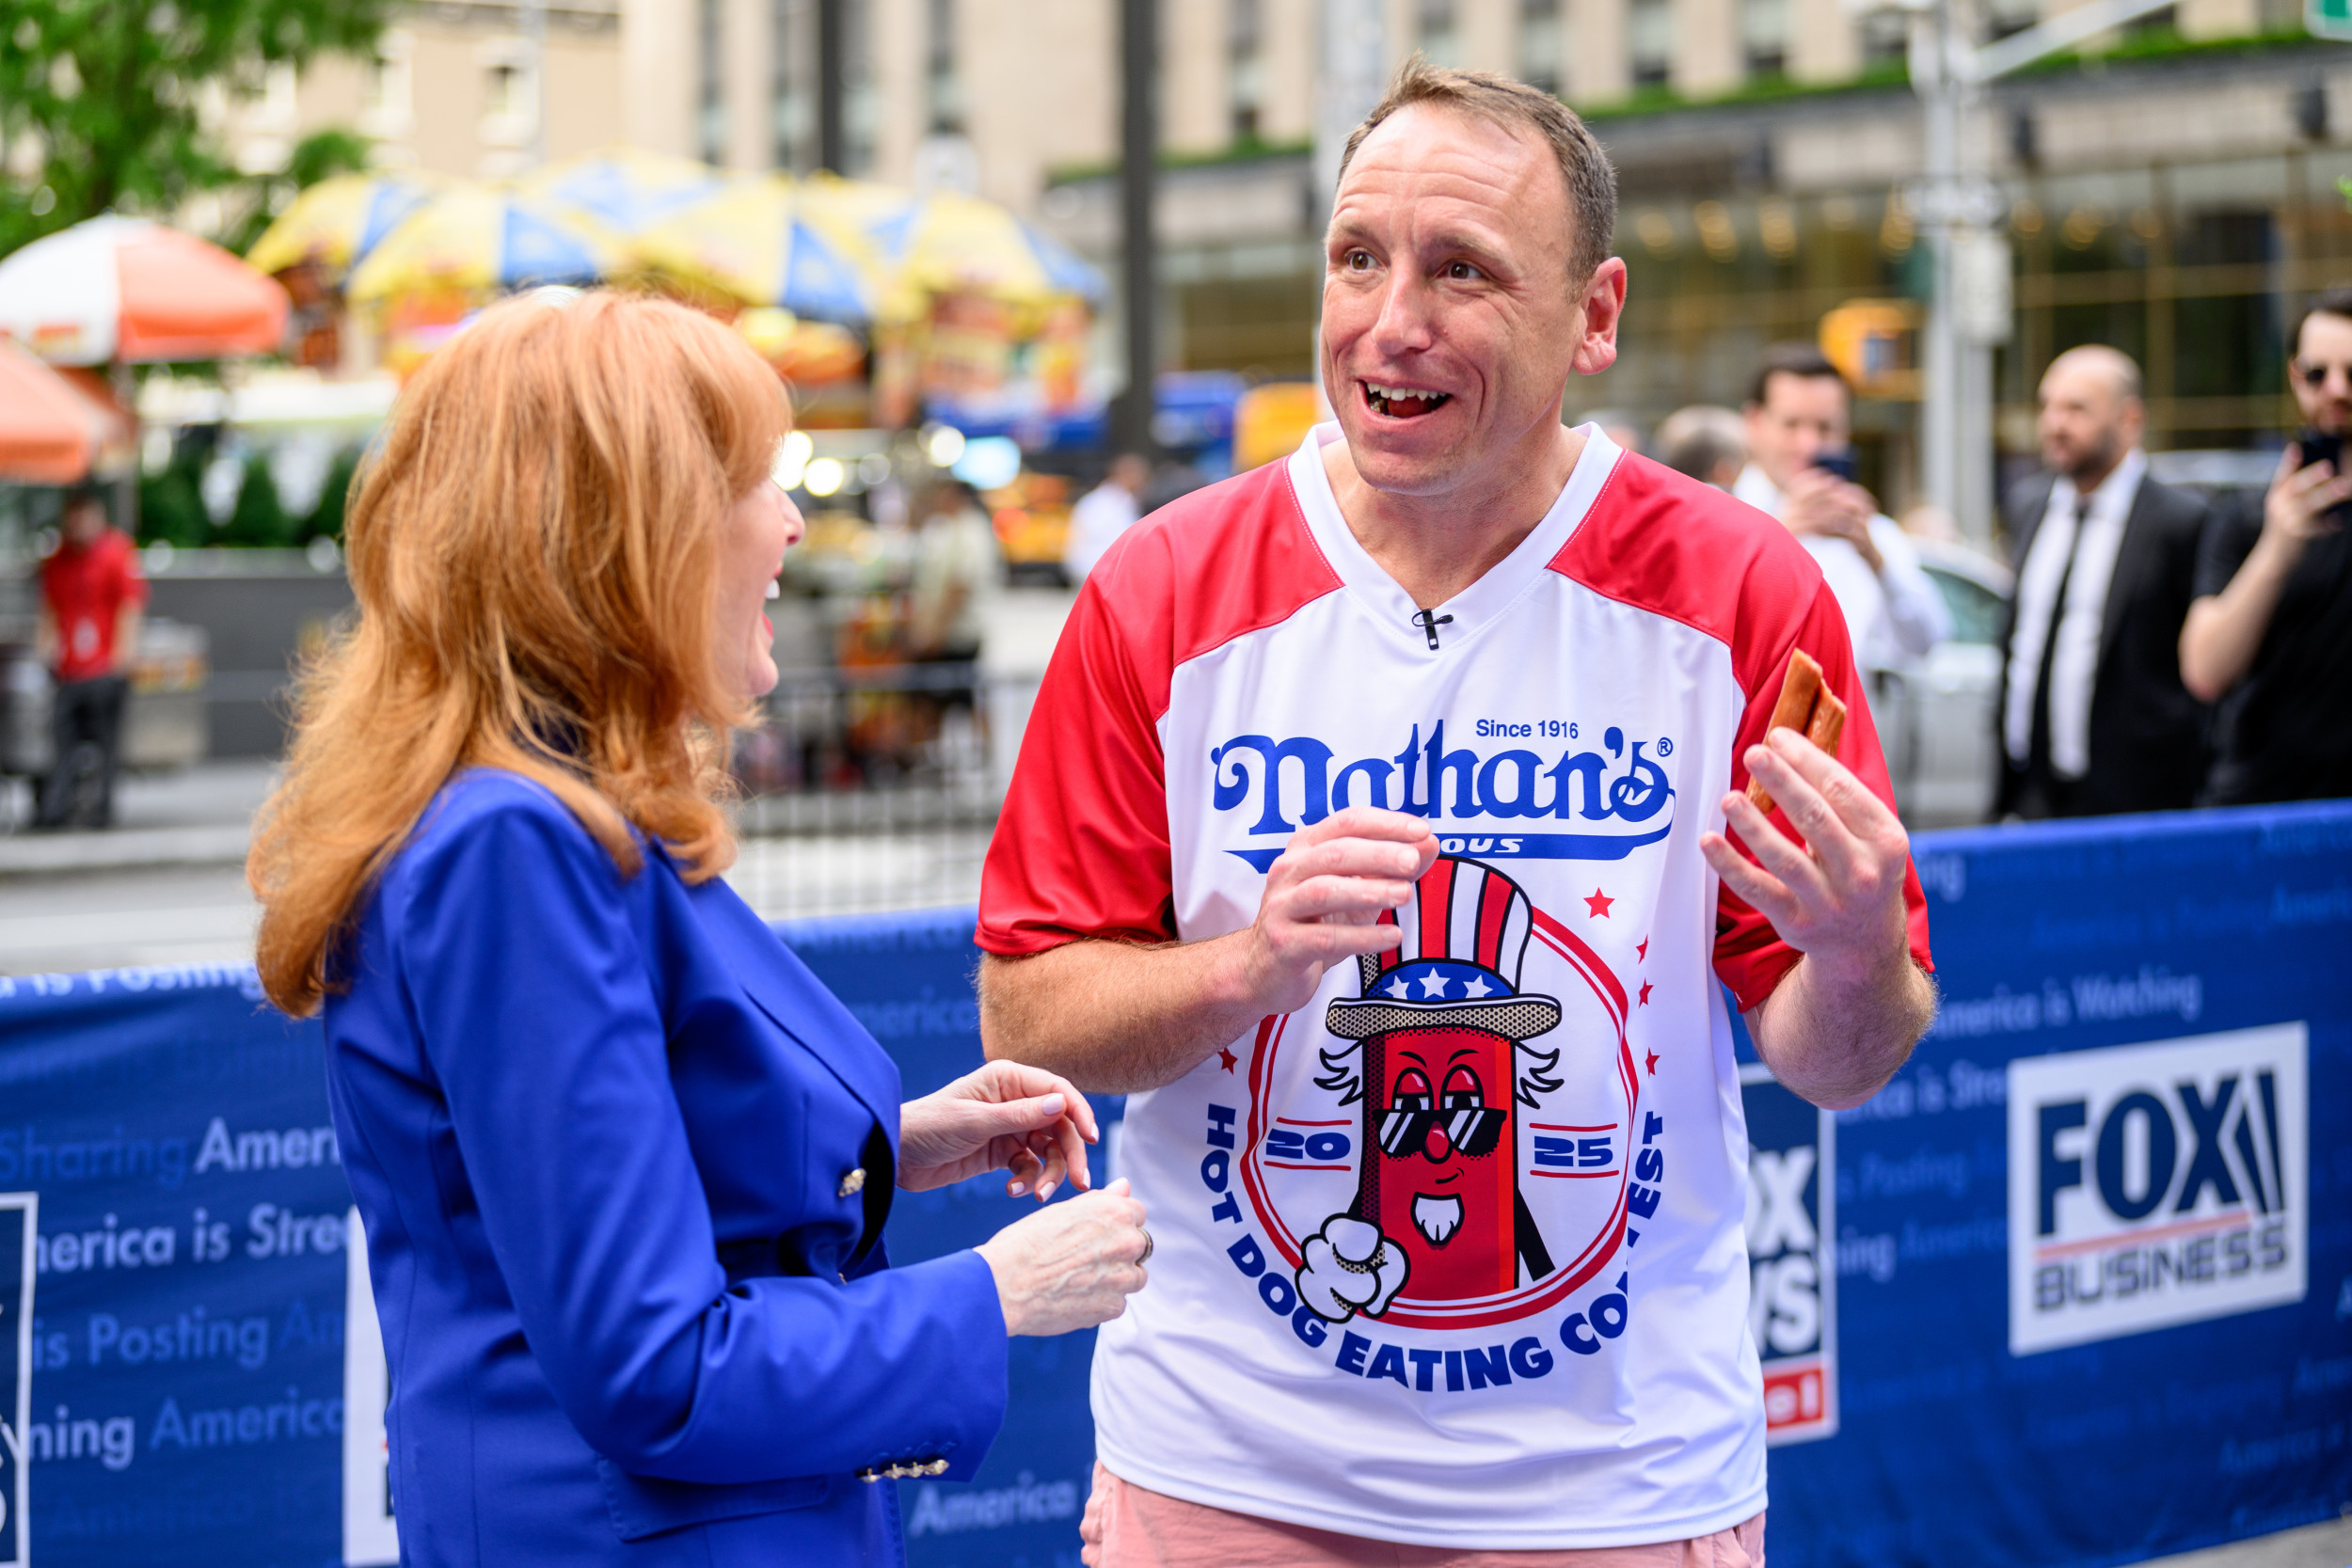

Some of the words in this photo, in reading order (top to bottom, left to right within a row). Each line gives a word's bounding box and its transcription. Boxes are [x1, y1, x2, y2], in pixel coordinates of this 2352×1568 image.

[1476, 720, 1532, 738] Since
[1537, 721, 1580, 740] 1916
[1265, 1129, 1351, 1161] 20
[1534, 1136, 1613, 1167] 25
[2037, 1070, 2243, 1237] FOX
[192, 1206, 231, 1263] is
[1200, 1102, 1244, 1227] HOT
[1226, 1233, 1328, 1349] DOG
[1335, 1330, 1554, 1393] EATING
[1560, 1111, 1663, 1355] COEST
[2034, 1224, 2288, 1311] BUSINESS
[87, 1304, 271, 1370] Posting
